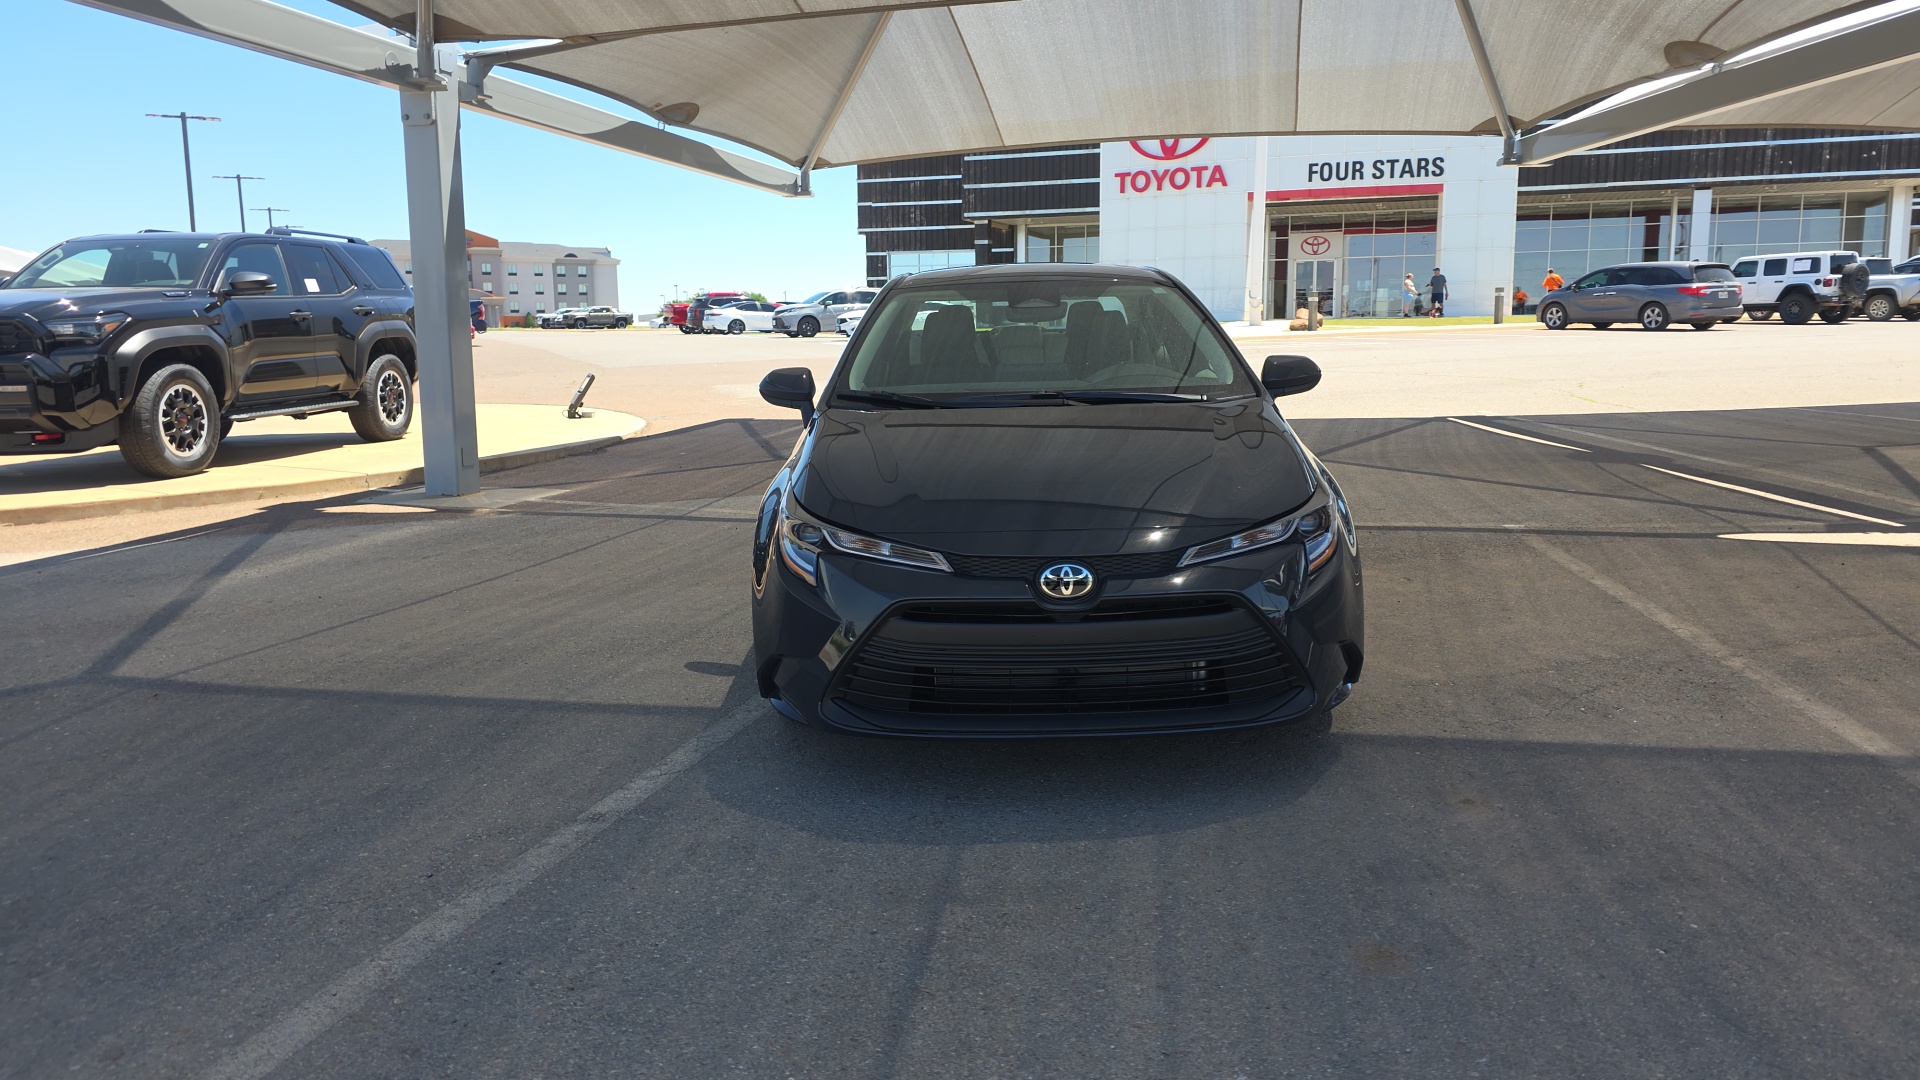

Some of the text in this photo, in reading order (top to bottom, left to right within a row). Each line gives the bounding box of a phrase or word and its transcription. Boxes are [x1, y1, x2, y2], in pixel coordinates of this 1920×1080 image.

[1114, 165, 1228, 193] TOYOTA
[1308, 157, 1444, 182] FOUR STARS
